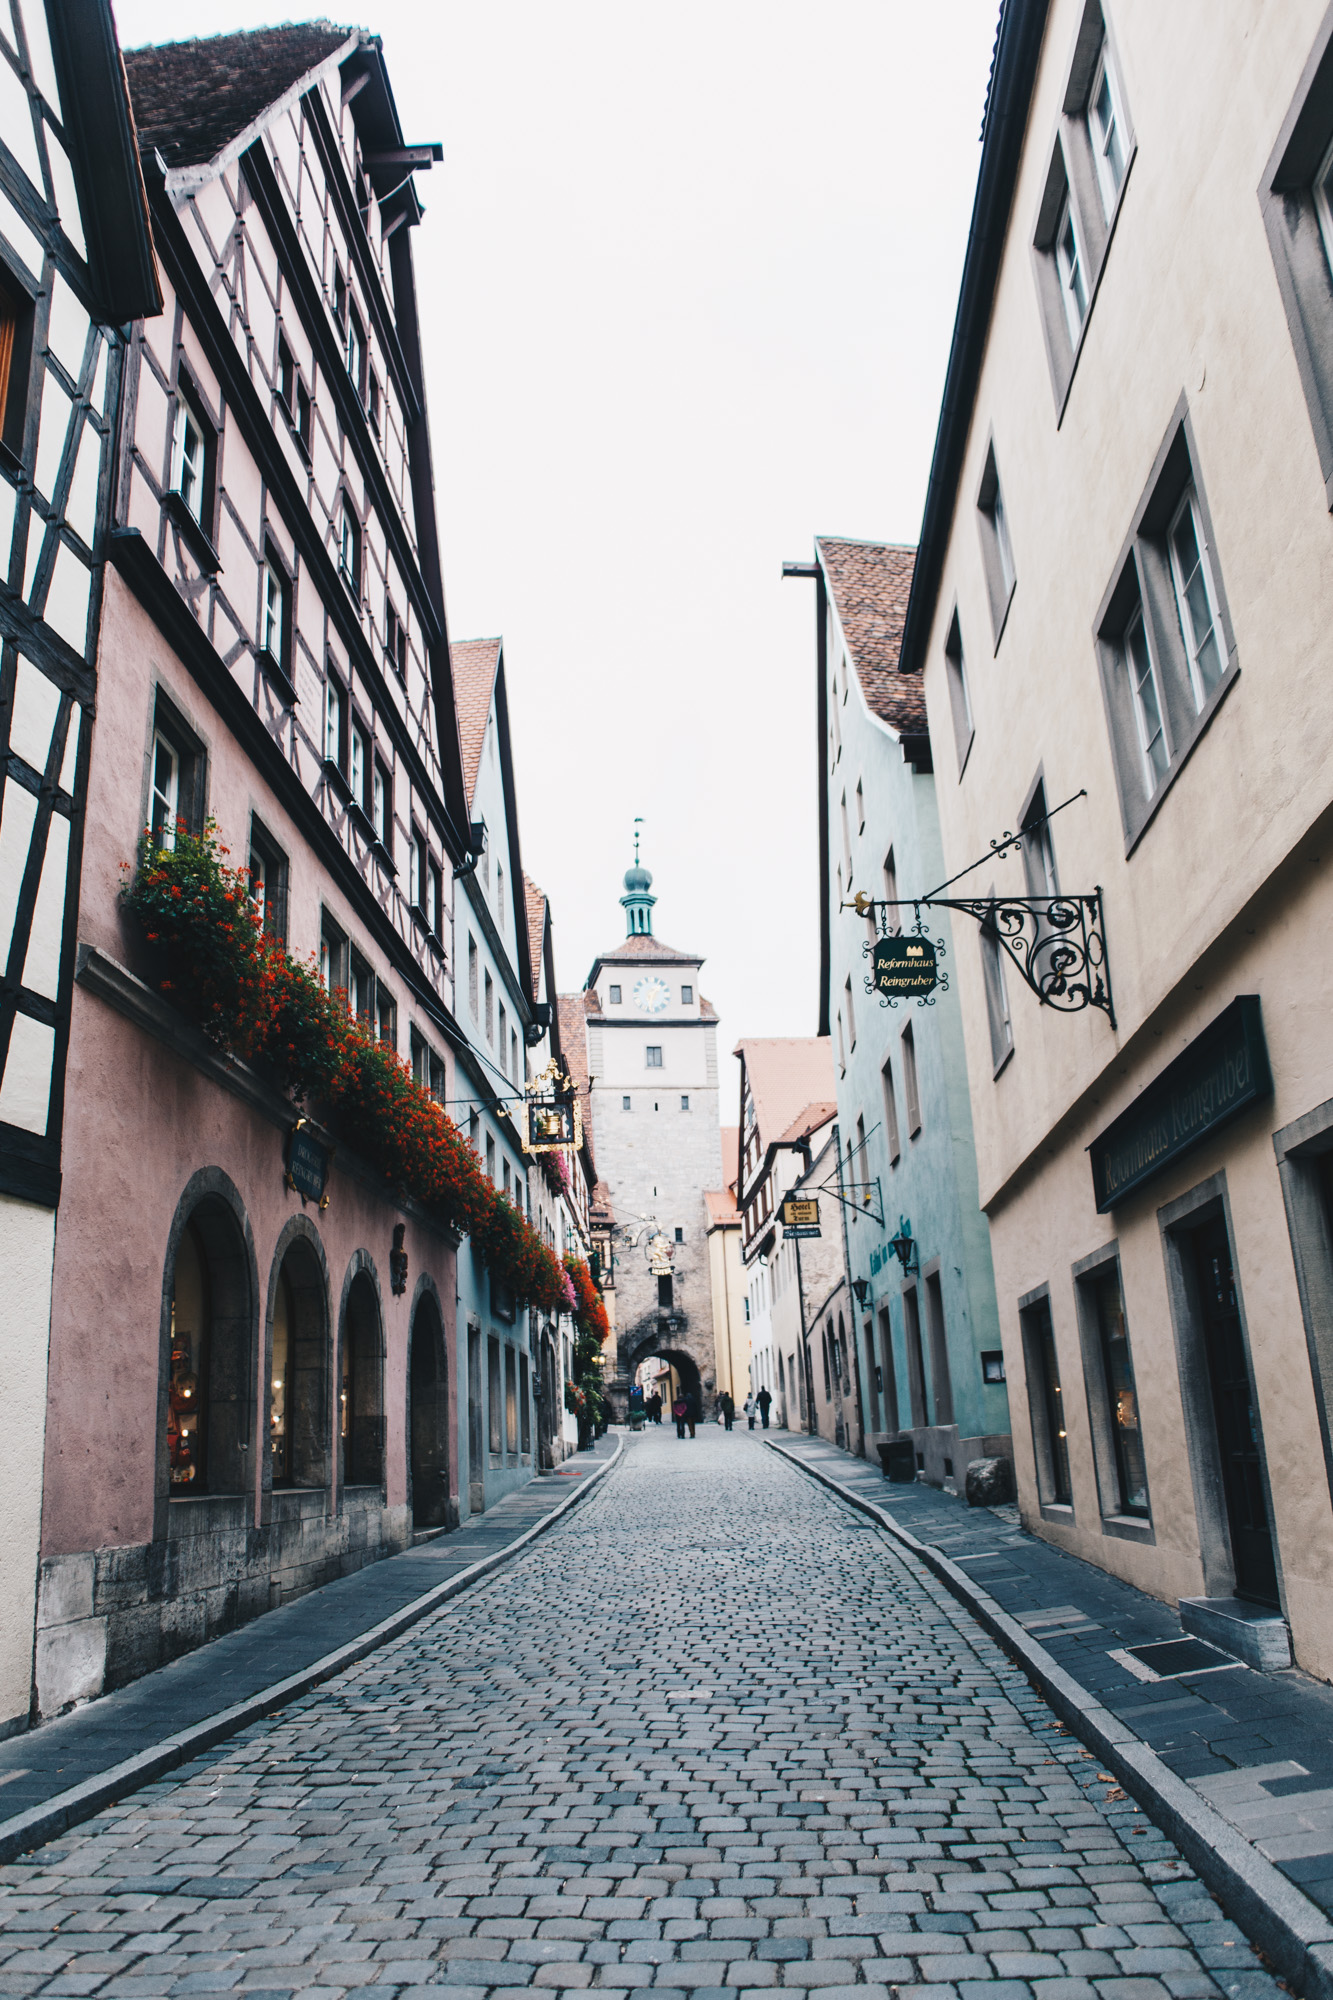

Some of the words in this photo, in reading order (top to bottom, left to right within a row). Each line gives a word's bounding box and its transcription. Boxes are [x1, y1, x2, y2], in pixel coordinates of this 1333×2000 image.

[877, 958, 934, 970] Reformhaus
[879, 975, 934, 988] Reingruber
[1104, 1119, 1169, 1195] Reformhaus
[1172, 1044, 1251, 1142] Reingruber
